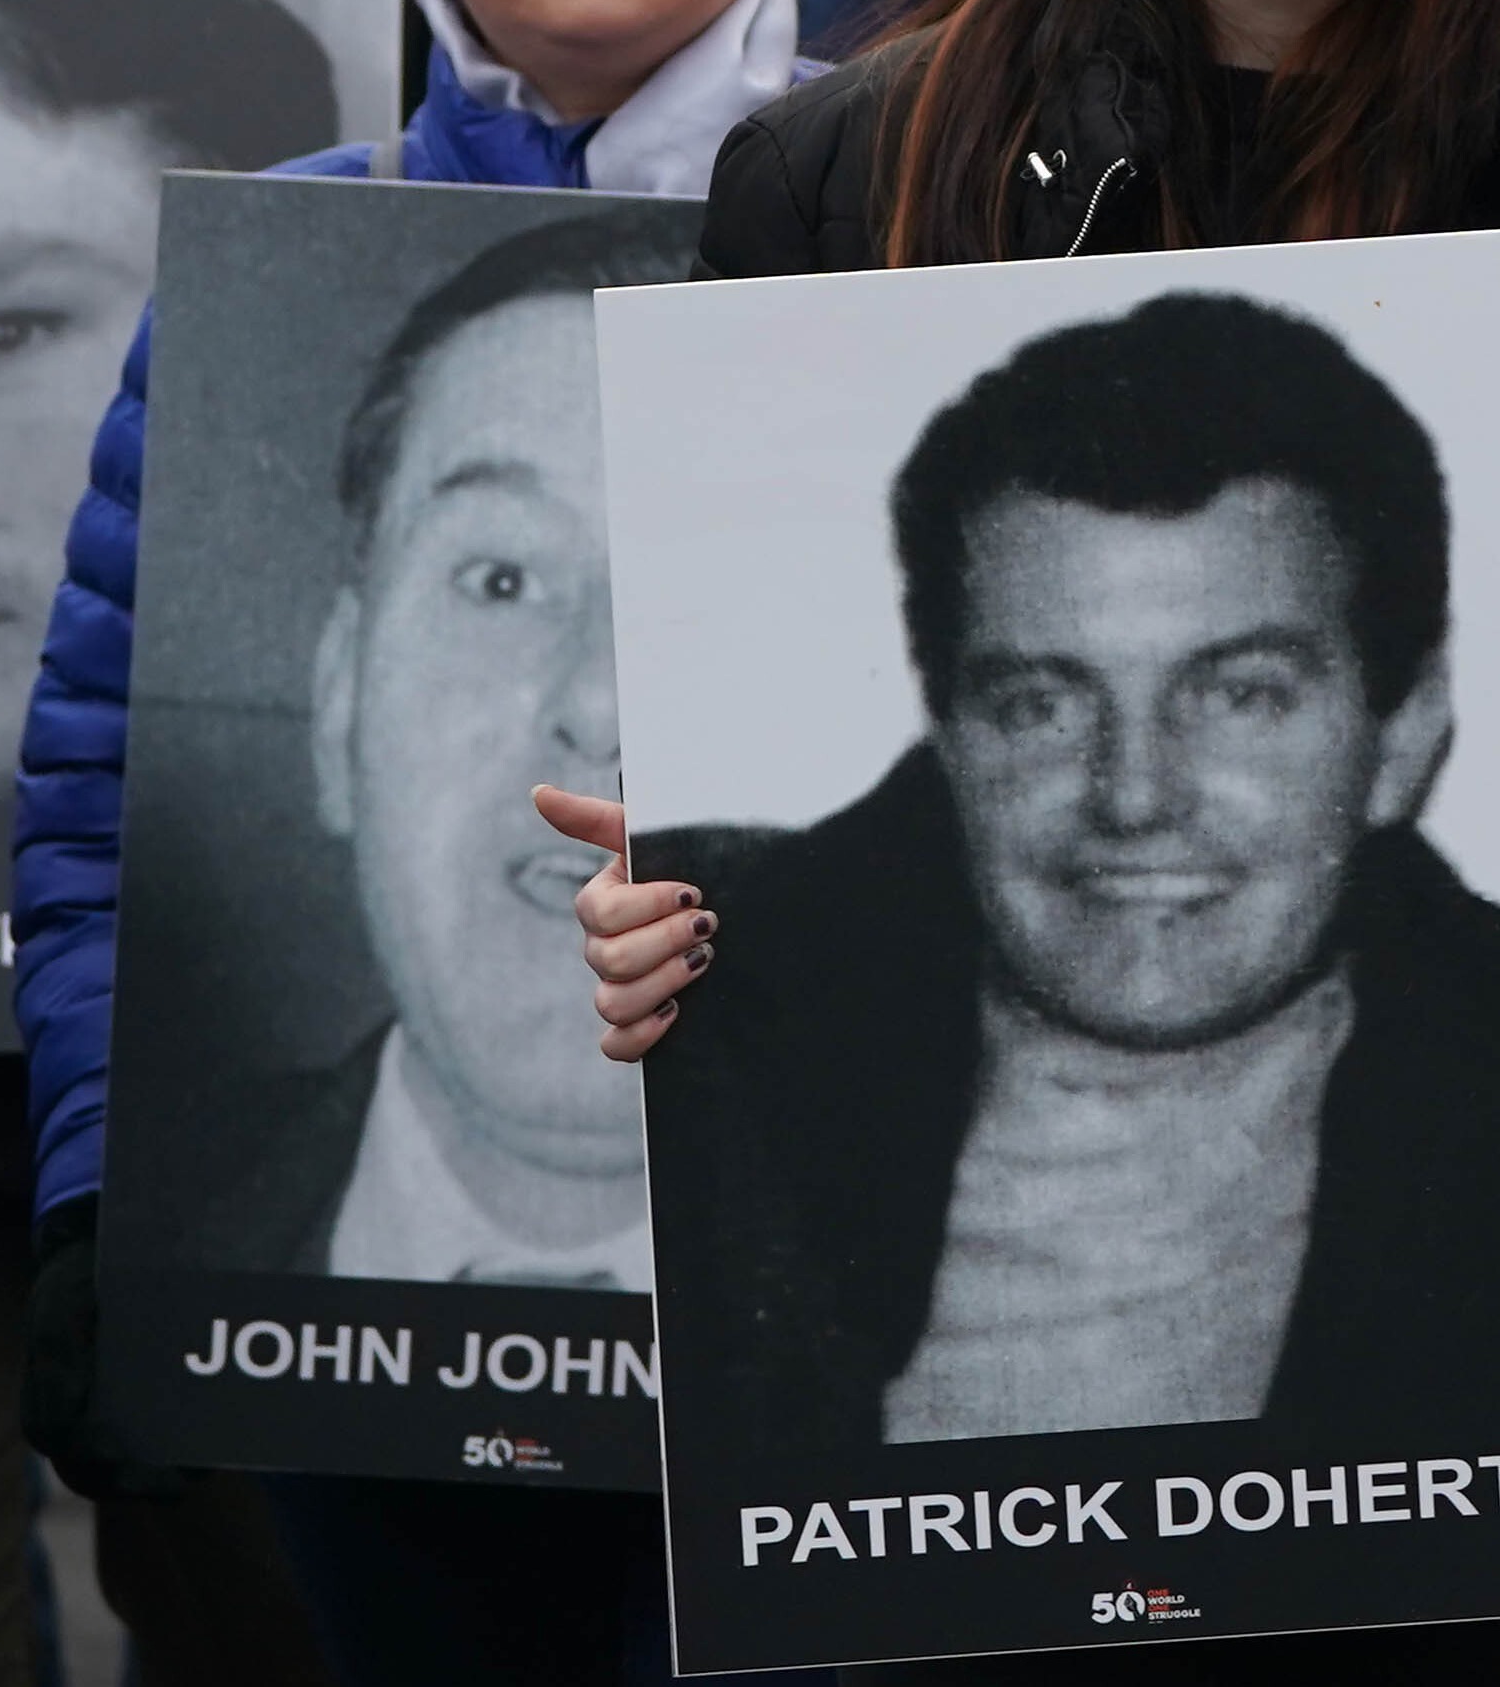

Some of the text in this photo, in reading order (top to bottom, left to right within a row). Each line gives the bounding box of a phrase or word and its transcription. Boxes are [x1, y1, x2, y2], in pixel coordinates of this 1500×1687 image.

[186, 1318, 412, 1385] JOHN
[740, 1481, 1129, 1567] PATRICK
[1147, 1594, 1186, 1605] WORLD
[1147, 1608, 1201, 1620] STRUGGLE
